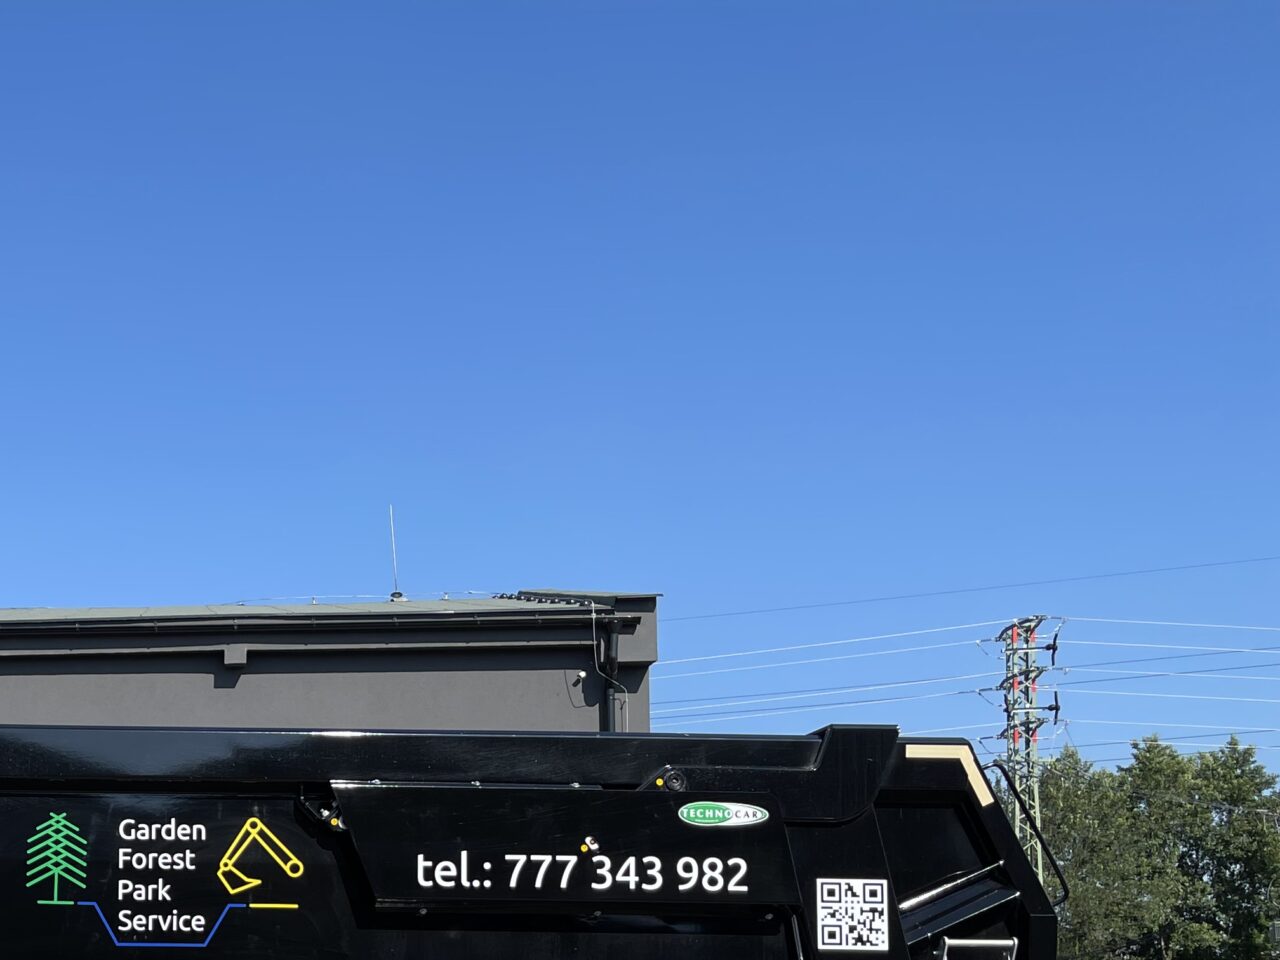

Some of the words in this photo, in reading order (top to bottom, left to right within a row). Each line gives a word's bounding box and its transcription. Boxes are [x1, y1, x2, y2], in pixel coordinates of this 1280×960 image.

[681, 808, 759, 819] TECHNOCAR
[118, 817, 207, 841] Garden
[118, 848, 196, 870] Forest
[417, 850, 492, 888] tel.:
[504, 854, 578, 889] 777
[590, 855, 663, 890] 343
[676, 856, 749, 892] 982
[117, 877, 172, 901] Park
[117, 908, 206, 932] Service
